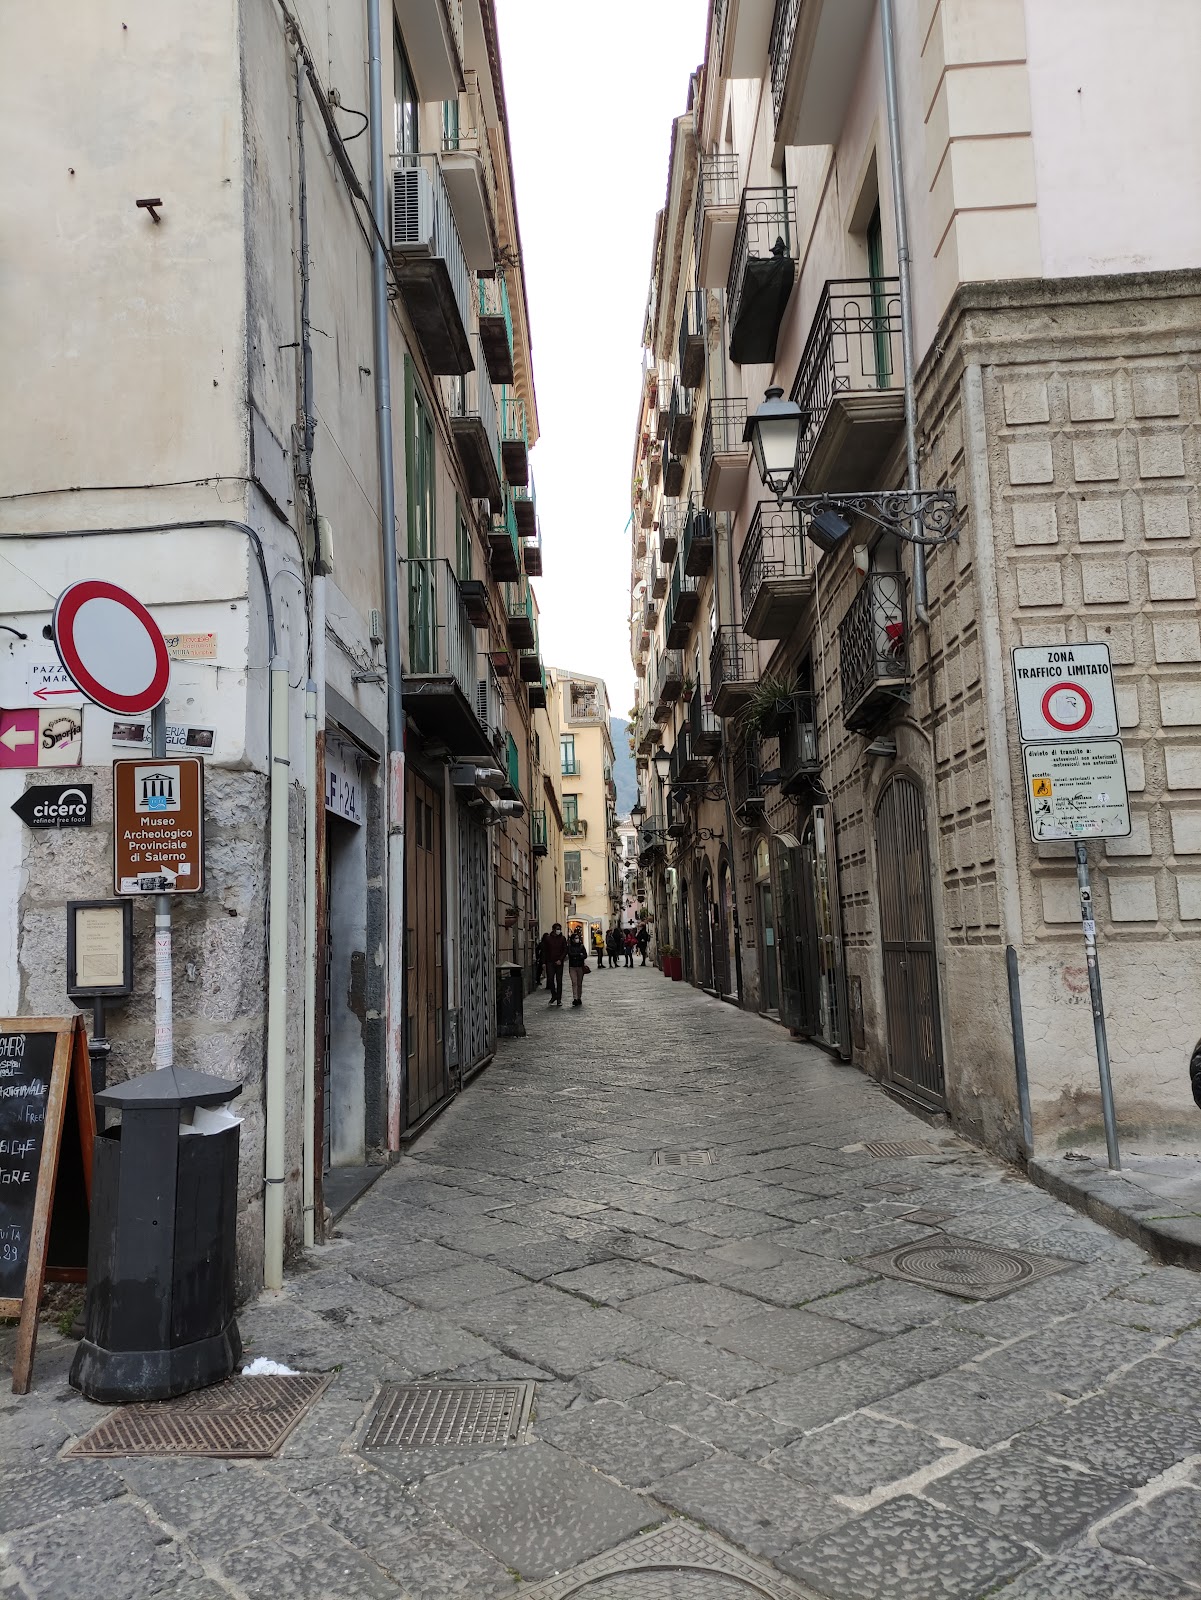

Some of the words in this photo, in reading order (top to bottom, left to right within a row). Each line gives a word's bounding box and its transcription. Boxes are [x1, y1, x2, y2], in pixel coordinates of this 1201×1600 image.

[1048, 652, 1074, 662] ZONA
[34, 666, 63, 674] PAZZ
[1017, 666, 1062, 678] TRAFFICO
[1067, 664, 1108, 676] LIMITATO
[42, 720, 82, 749] Smorfia
[34, 800, 86, 816] cicero
[140, 816, 175, 826] Museo
[124, 828, 193, 839] Archeologico
[129, 840, 187, 850] Provinciale
[130, 853, 140, 862] di
[145, 852, 186, 862] Salerno
